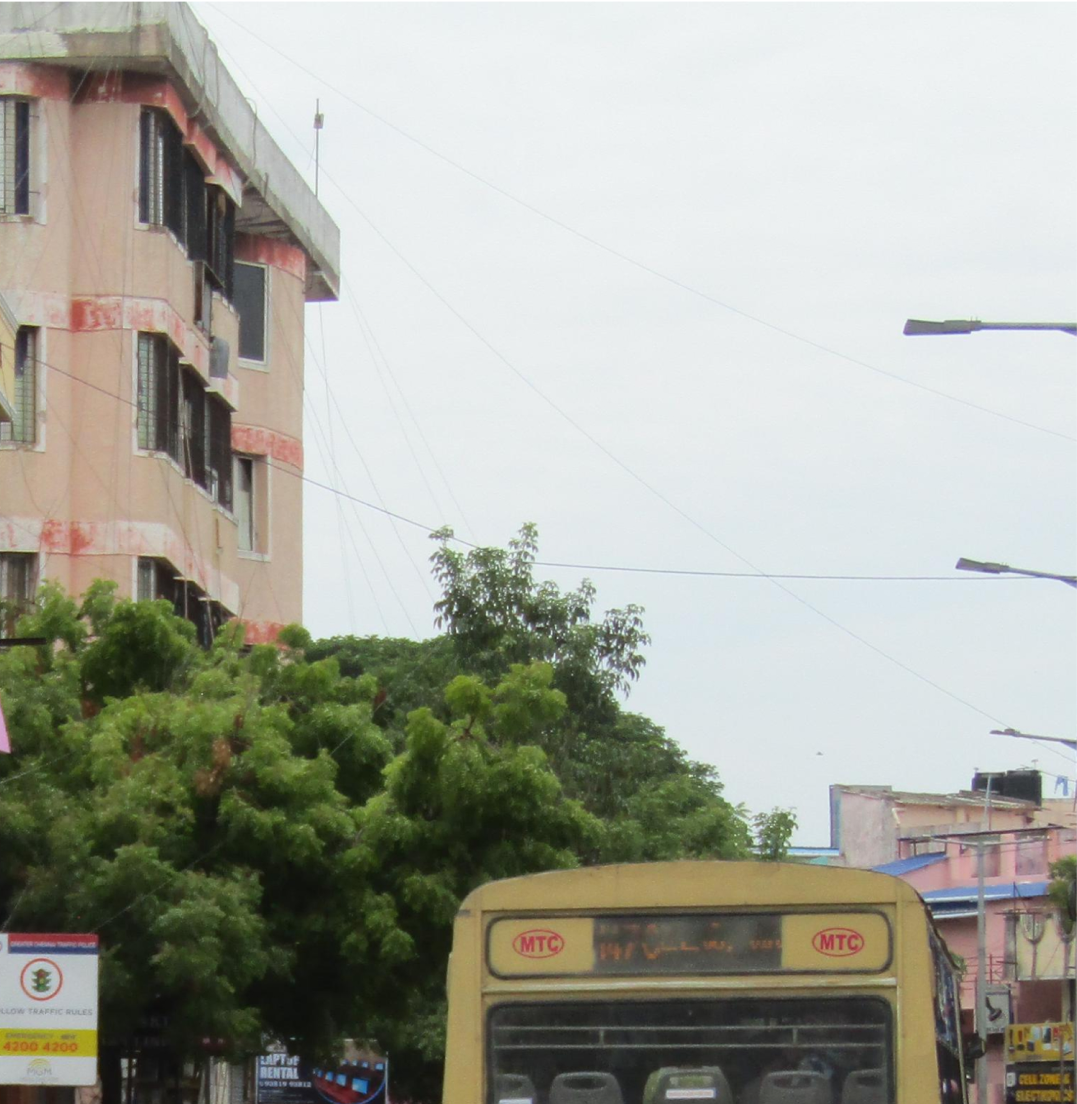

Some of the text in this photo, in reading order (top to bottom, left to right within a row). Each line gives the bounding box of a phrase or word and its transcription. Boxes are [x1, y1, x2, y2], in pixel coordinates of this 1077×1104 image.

[520, 935, 559, 953] MTC
[818, 934, 857, 951] MTC
[28, 1008, 63, 1016] TRAFFIC
[3, 1041, 78, 1053] 4200 4200
[260, 1066, 299, 1080] RENTAL
